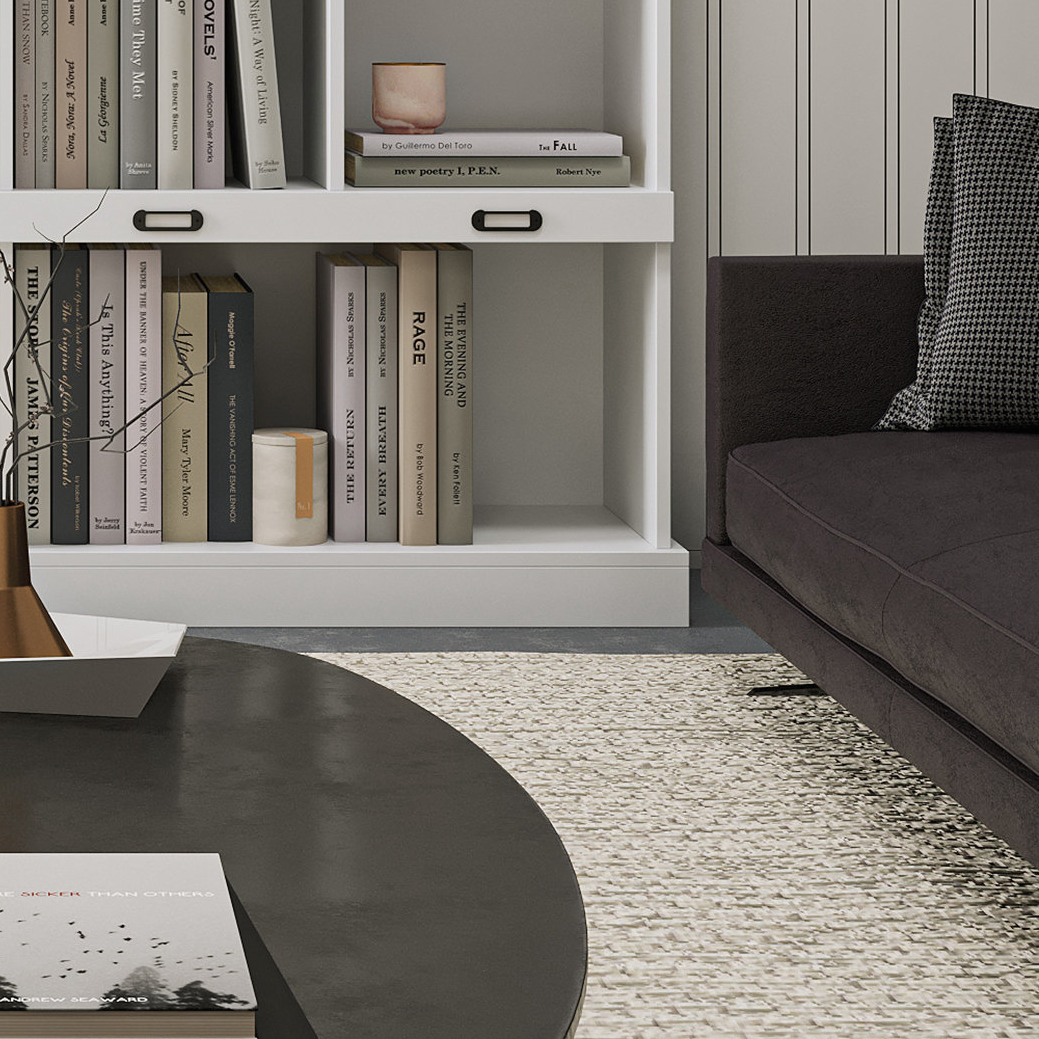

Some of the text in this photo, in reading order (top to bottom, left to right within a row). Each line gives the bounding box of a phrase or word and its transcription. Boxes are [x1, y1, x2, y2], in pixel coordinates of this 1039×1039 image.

[130, 30, 145, 65] They
[132, 72, 144, 99] Met
[438, 141, 451, 149] Del
[454, 141, 472, 149] Toro
[420, 168, 454, 176] poetry
[102, 324, 113, 355] This
[413, 312, 425, 364] RAGE
[100, 360, 114, 434] Anything?
[180, 429, 191, 516] Mary Tyler Moore
[21, 890, 80, 898] SICKER
